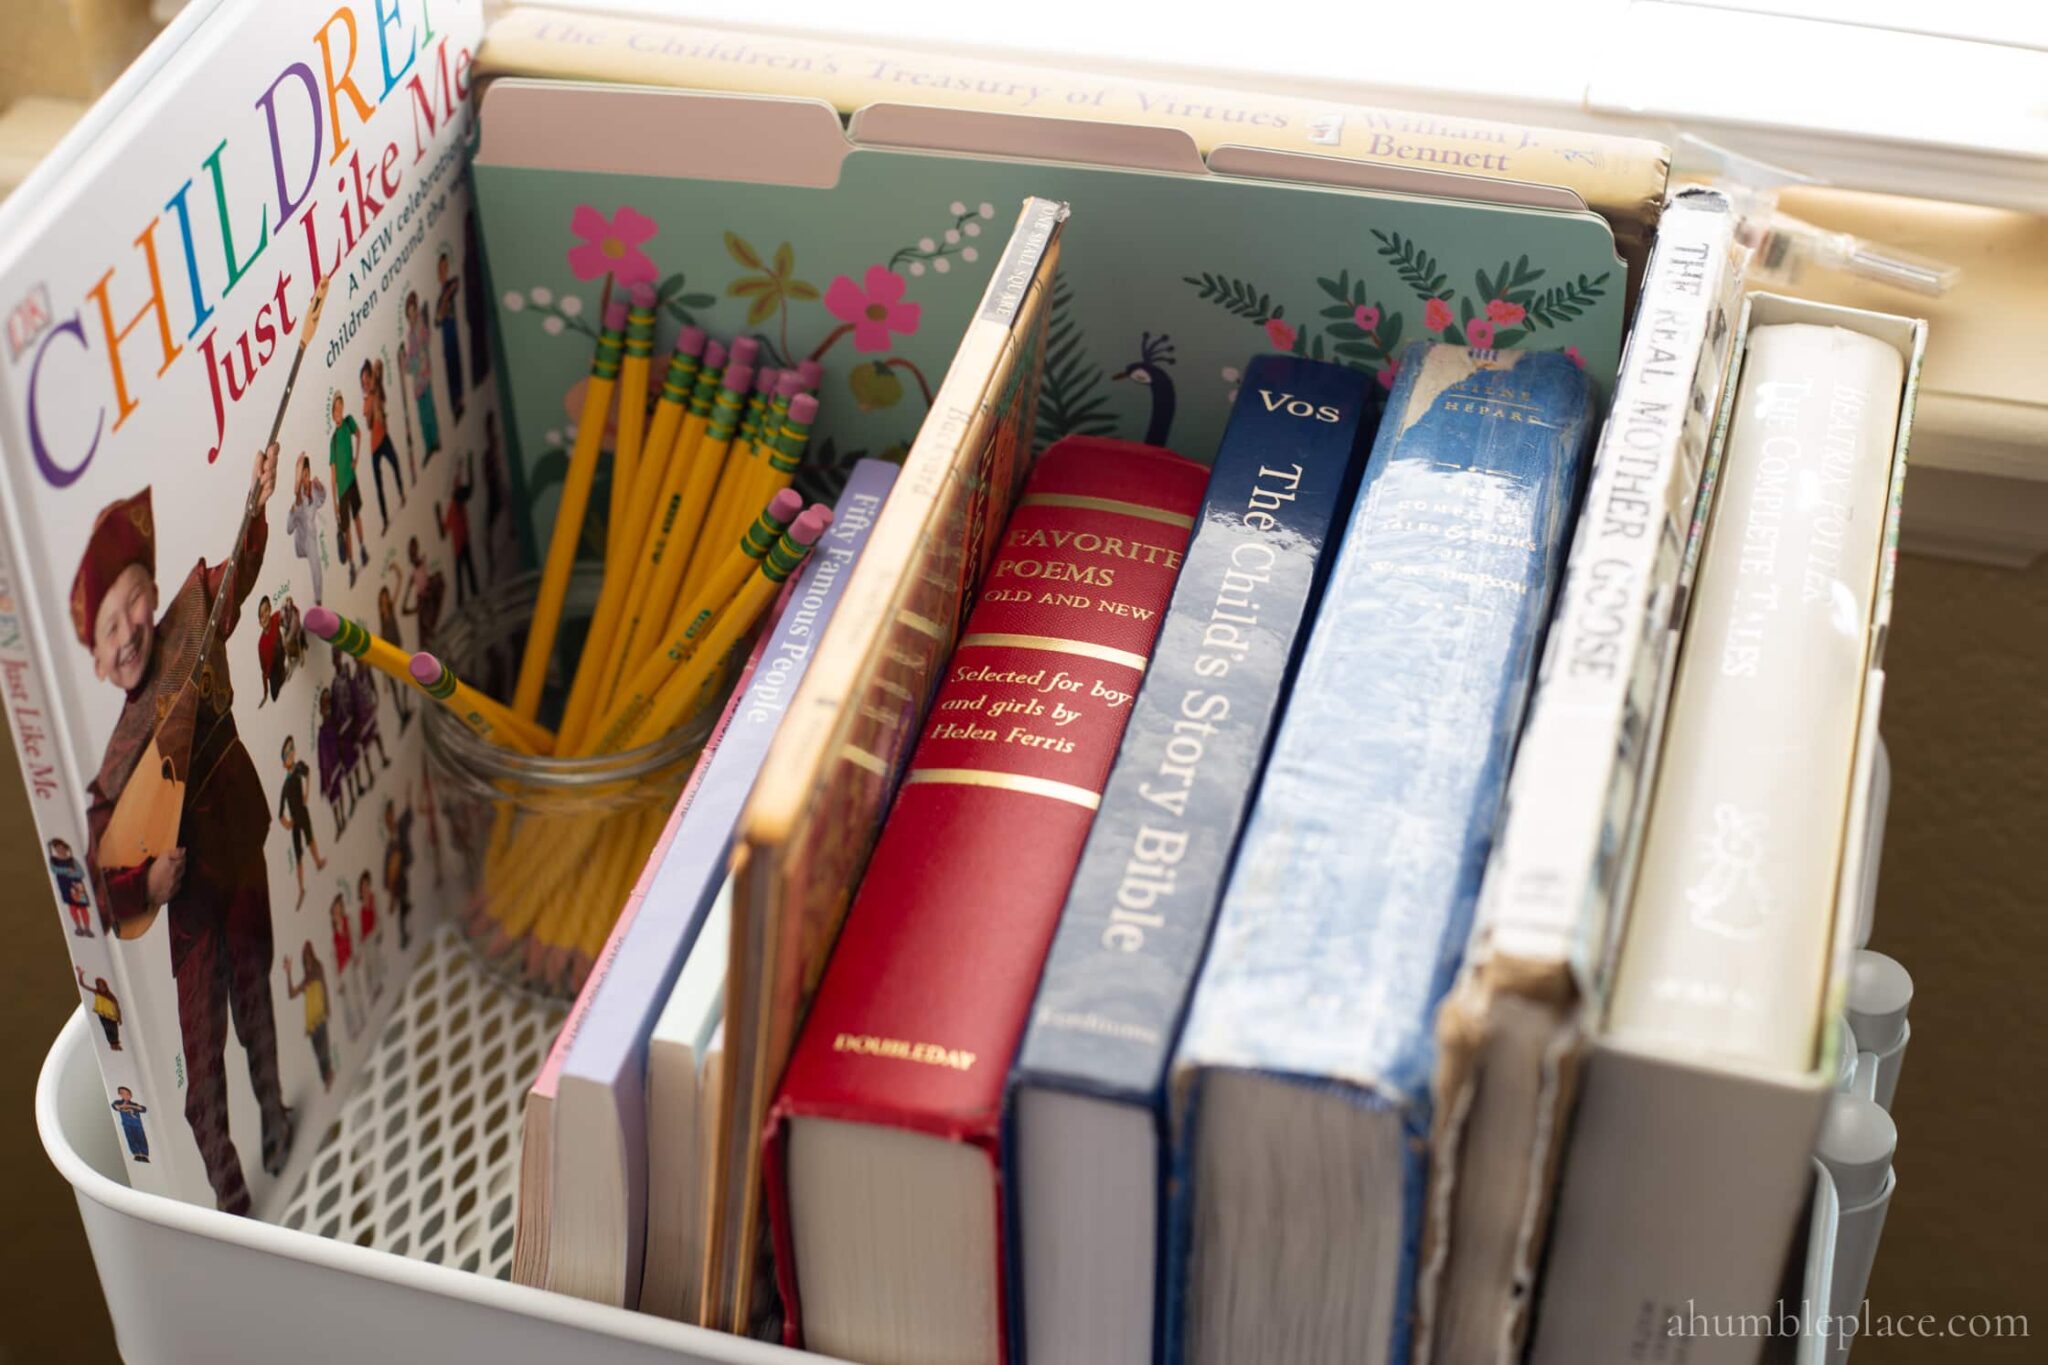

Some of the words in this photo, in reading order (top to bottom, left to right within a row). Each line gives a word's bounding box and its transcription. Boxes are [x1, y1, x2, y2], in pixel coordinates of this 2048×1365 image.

[532, 21, 608, 47] The
[628, 29, 840, 76] Children's
[864, 58, 1045, 107] Treasury
[1066, 86, 1107, 106] of
[1136, 91, 1289, 129] Virtues
[1363, 112, 1507, 144] William
[1367, 132, 1511, 172] Bennett
[1034, 205, 1056, 229] ONE
[197, 270, 298, 465] Just
[299, 141, 402, 302] Like
[406, 33, 472, 166] Me
[348, 272, 359, 299] A
[360, 221, 394, 281] NEW
[1018, 232, 1042, 266] SMALL
[1670, 242, 1709, 298] THE
[326, 290, 378, 369] children
[381, 219, 425, 292] around
[996, 270, 1026, 316] SQUARE
[1640, 307, 1687, 386] REAL
[1242, 462, 1303, 531] The
[1601, 400, 1669, 543] MOTHER
[829, 492, 880, 544] Fifty
[1740, 433, 1801, 577] COMPLETE
[994, 559, 1116, 587] POEMS
[1008, 528, 1183, 570] FAVORITE
[789, 546, 855, 637] Famous
[984, 589, 1032, 602] OLD
[1038, 592, 1091, 609] AND
[1097, 599, 1155, 621] NEW
[1194, 542, 1276, 679] Child's
[1570, 558, 1628, 682] GOOSE
[2, 658, 29, 702] Just
[747, 640, 811, 723] People
[951, 665, 1046, 686] Selected
[1038, 671, 1084, 693] for
[1090, 680, 1133, 708] boy
[15, 707, 45, 758] Like
[941, 694, 988, 711] and
[987, 698, 1045, 717] girls
[1051, 703, 1082, 726] by
[931, 722, 998, 741] Helen
[1004, 727, 1076, 754] Ferris
[1137, 689, 1230, 818] Story
[29, 763, 57, 799] Me
[1101, 824, 1188, 953] Bible
[833, 1032, 977, 1071] DOUBLEDAY
